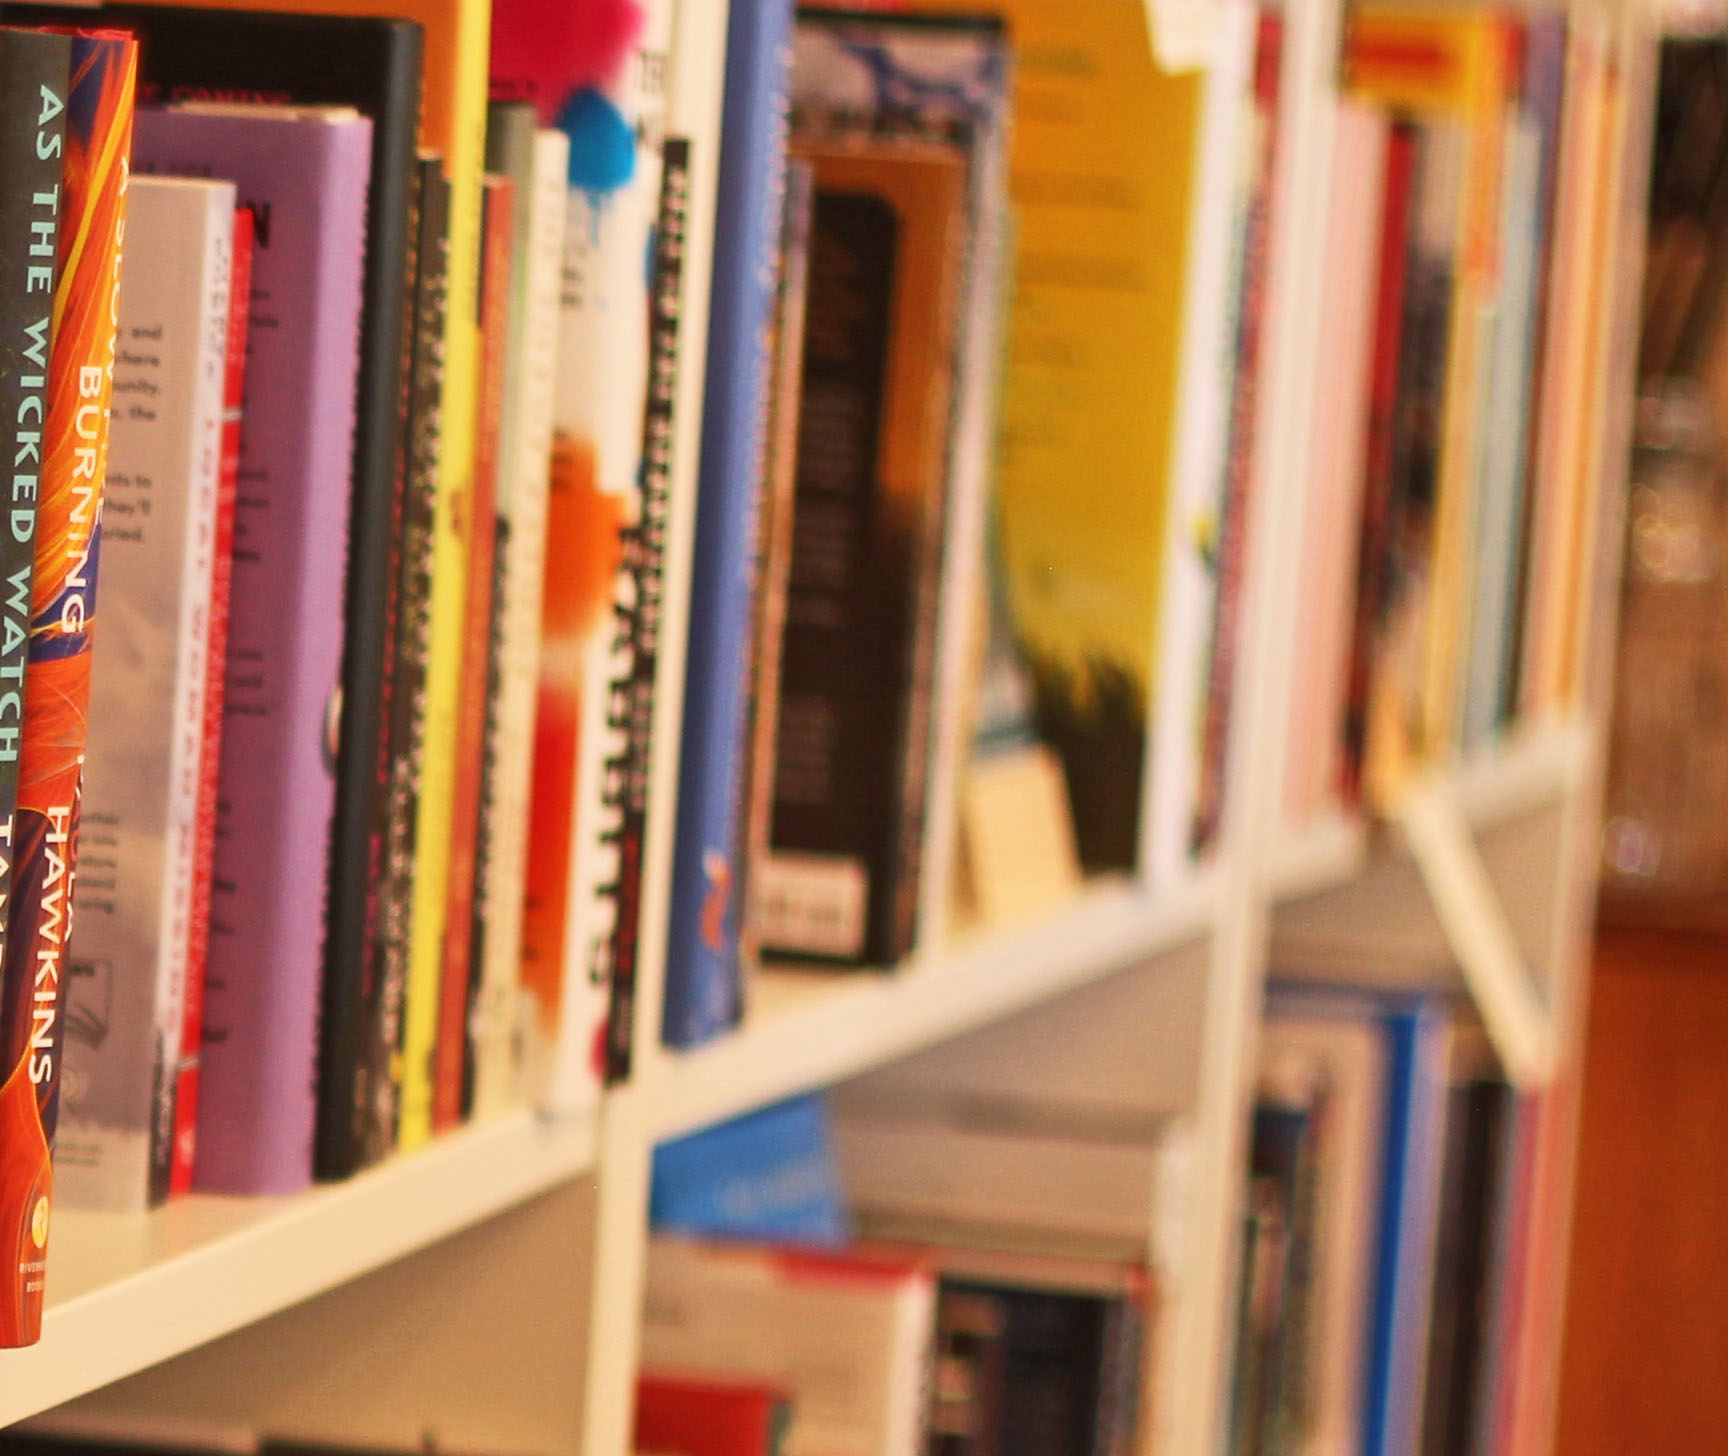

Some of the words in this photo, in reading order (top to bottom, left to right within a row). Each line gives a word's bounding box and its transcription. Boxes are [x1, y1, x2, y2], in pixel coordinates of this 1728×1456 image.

[35, 85, 65, 160] AS
[26, 185, 58, 292] THE
[8, 317, 49, 542] WICKED
[59, 364, 104, 635] BURNING
[27, 805, 71, 1085] HAWKINS
